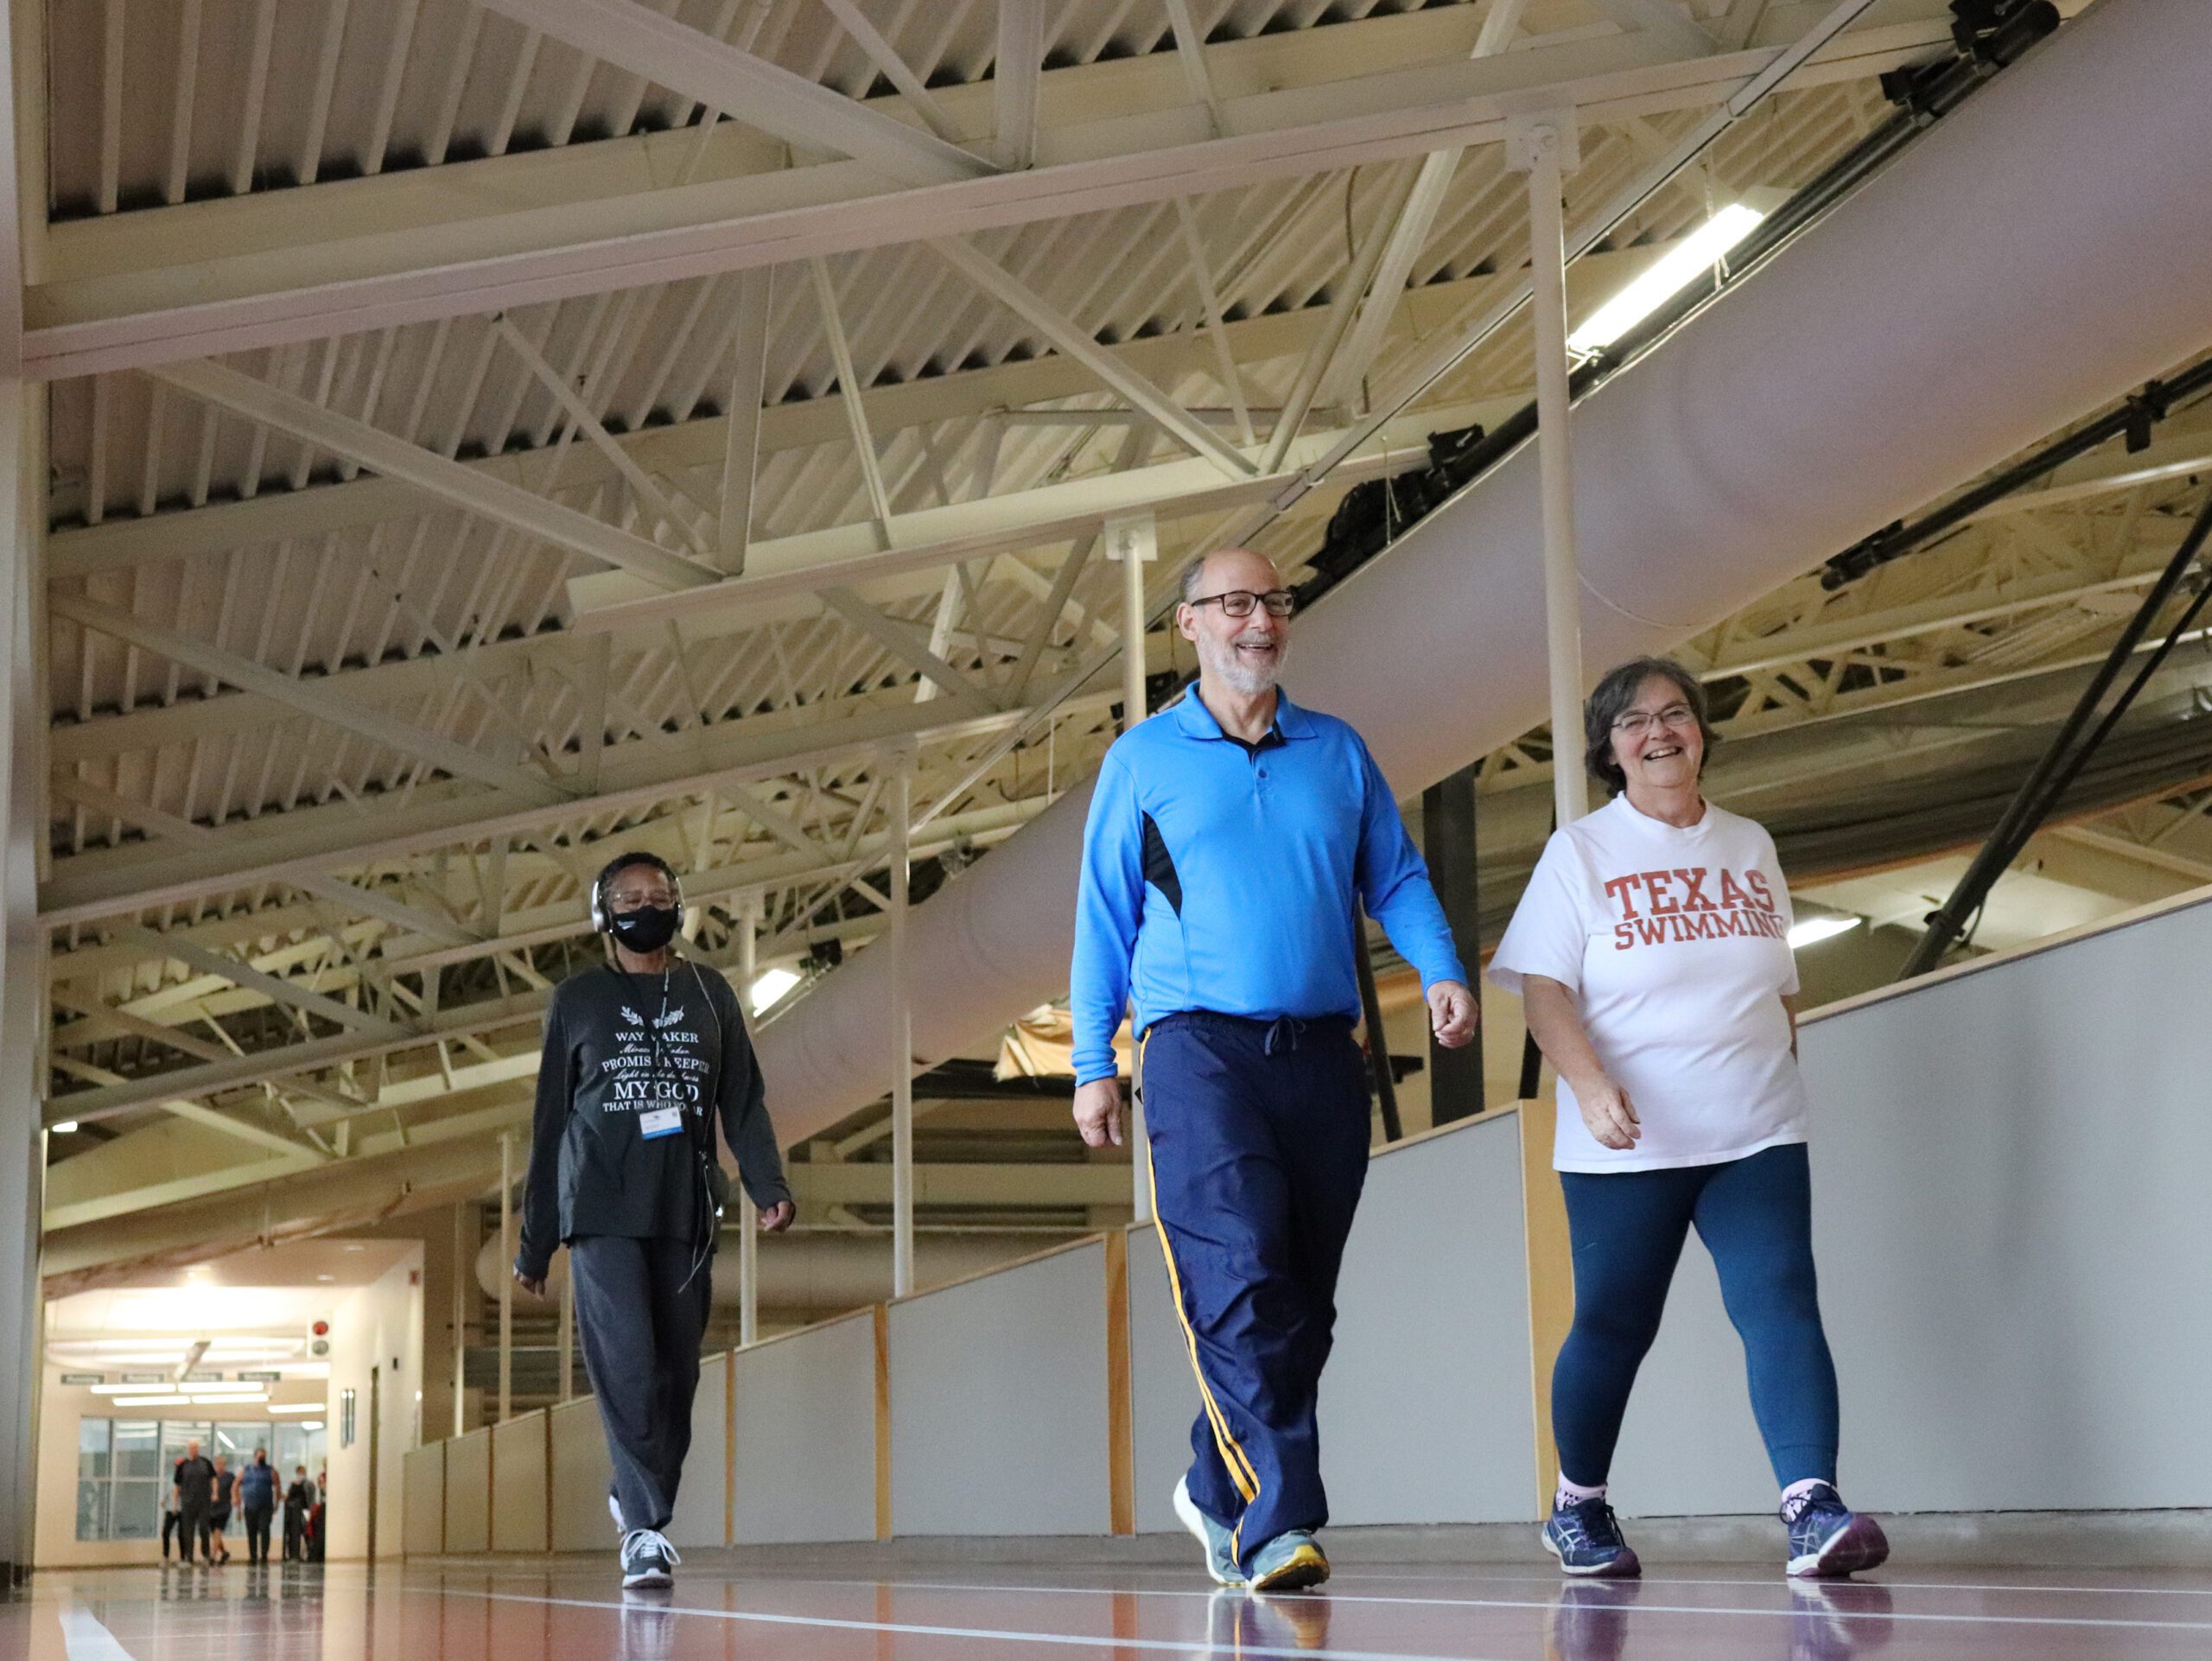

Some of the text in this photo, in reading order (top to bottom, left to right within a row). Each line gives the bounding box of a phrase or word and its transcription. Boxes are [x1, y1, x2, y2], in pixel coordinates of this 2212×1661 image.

[1604, 867, 1775, 921] TEXAS
[1614, 909, 1786, 951] SWIMMING
[615, 1031, 699, 1043] WAY AKER
[601, 1055, 659, 1072] PROMIS
[613, 1080, 699, 1102] MY GOD
[602, 1101, 631, 1112] THAT
[633, 1100, 644, 1110] IS
[646, 1100, 671, 1110] WHO
